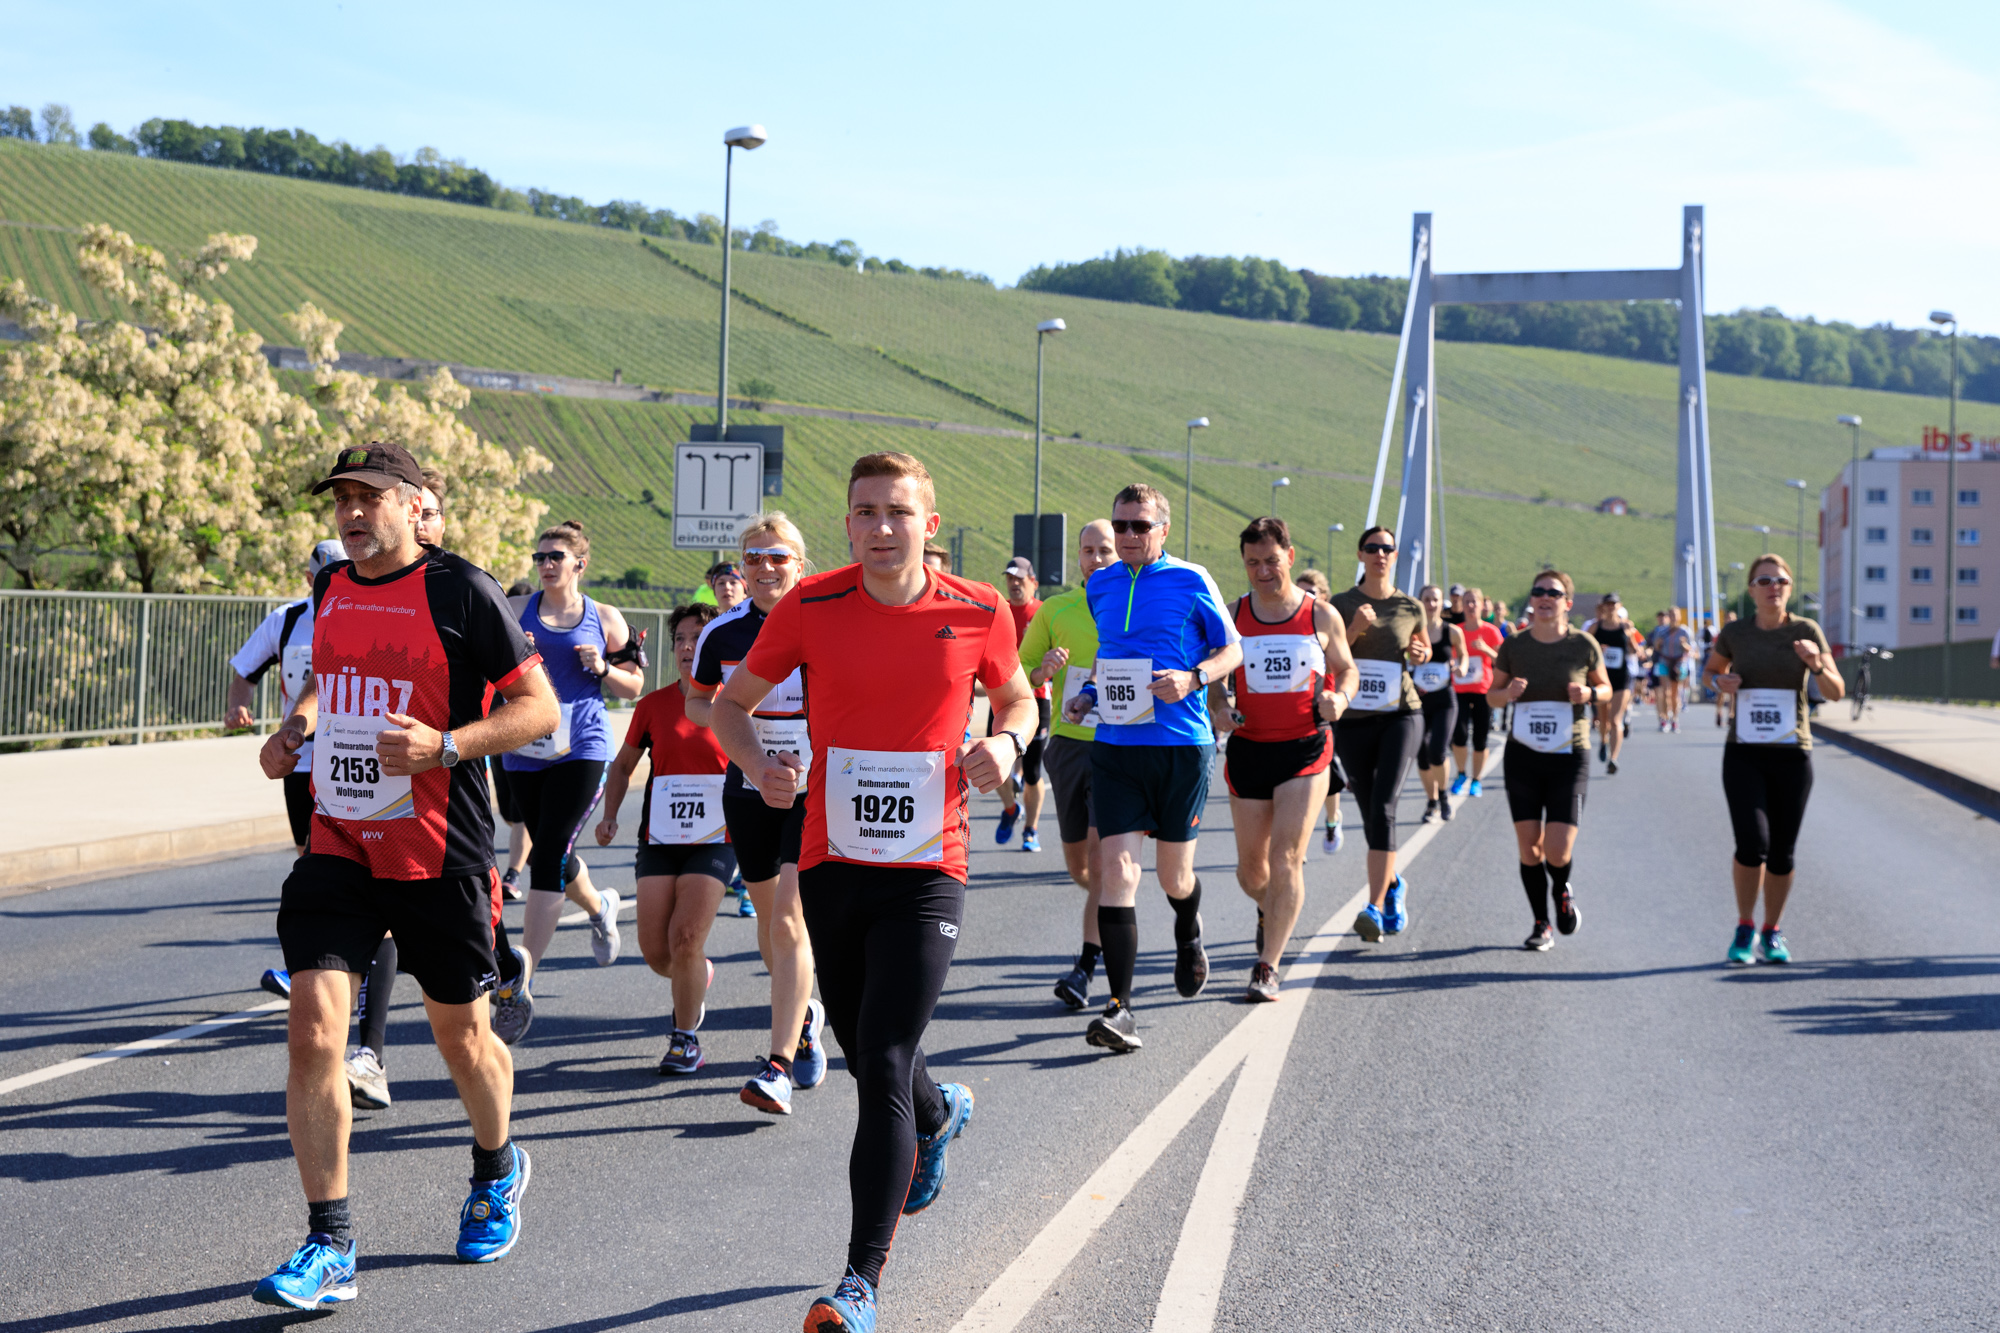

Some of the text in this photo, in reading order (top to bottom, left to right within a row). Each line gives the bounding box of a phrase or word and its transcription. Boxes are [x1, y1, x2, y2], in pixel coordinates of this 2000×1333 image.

[698, 520, 735, 531] Bitte
[677, 534, 737, 544] einordn
[354, 603, 385, 612] marathon
[386, 605, 416, 617] würzburg
[1264, 656, 1291, 673] 253
[1105, 684, 1136, 701] 1685
[1111, 703, 1128, 711] Harald
[1749, 710, 1782, 725] 1868
[346, 728, 369, 736] marathon
[1528, 721, 1558, 735] 1867
[333, 741, 374, 752] Halbmarathon
[330, 755, 380, 784] 2153
[859, 764, 876, 772] iwelt
[877, 765, 905, 773] marathon
[857, 779, 910, 789] Halbmarathon
[335, 786, 375, 799] Wolfgang
[669, 801, 706, 819] 1274
[851, 794, 915, 824] 1926
[680, 821, 694, 829] Ralf
[858, 827, 906, 839] Johannes
